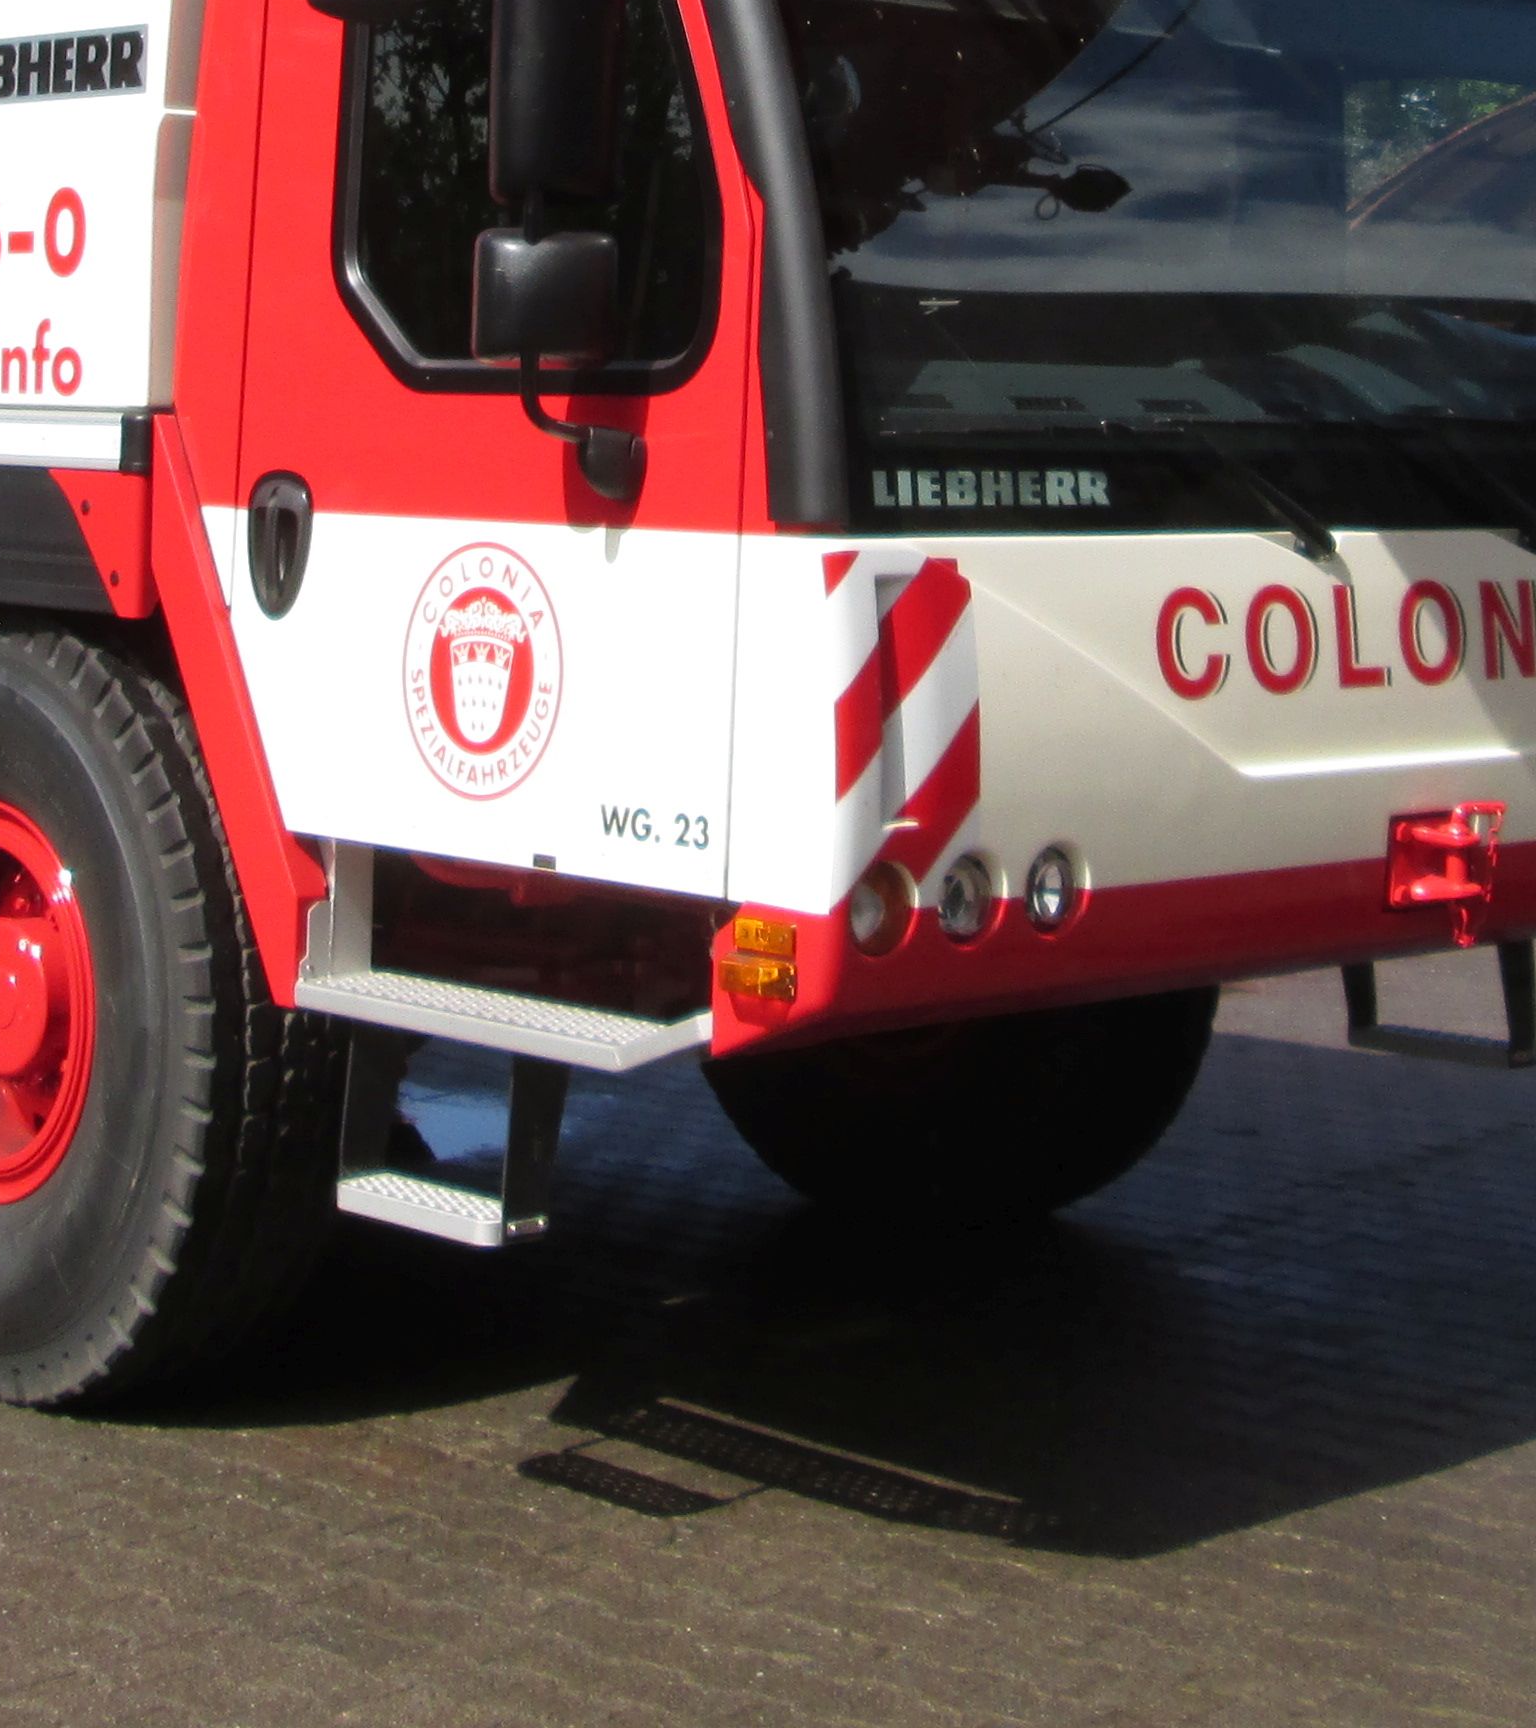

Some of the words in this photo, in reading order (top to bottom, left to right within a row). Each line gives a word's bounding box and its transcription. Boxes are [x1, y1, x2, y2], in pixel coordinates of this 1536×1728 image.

[872, 470, 1110, 507] LIEBHERR
[422, 555, 545, 631] COLONIA
[409, 667, 553, 787] SPEZIALFAHRZEUGE
[600, 804, 661, 843] WG.
[674, 813, 710, 851] 23
